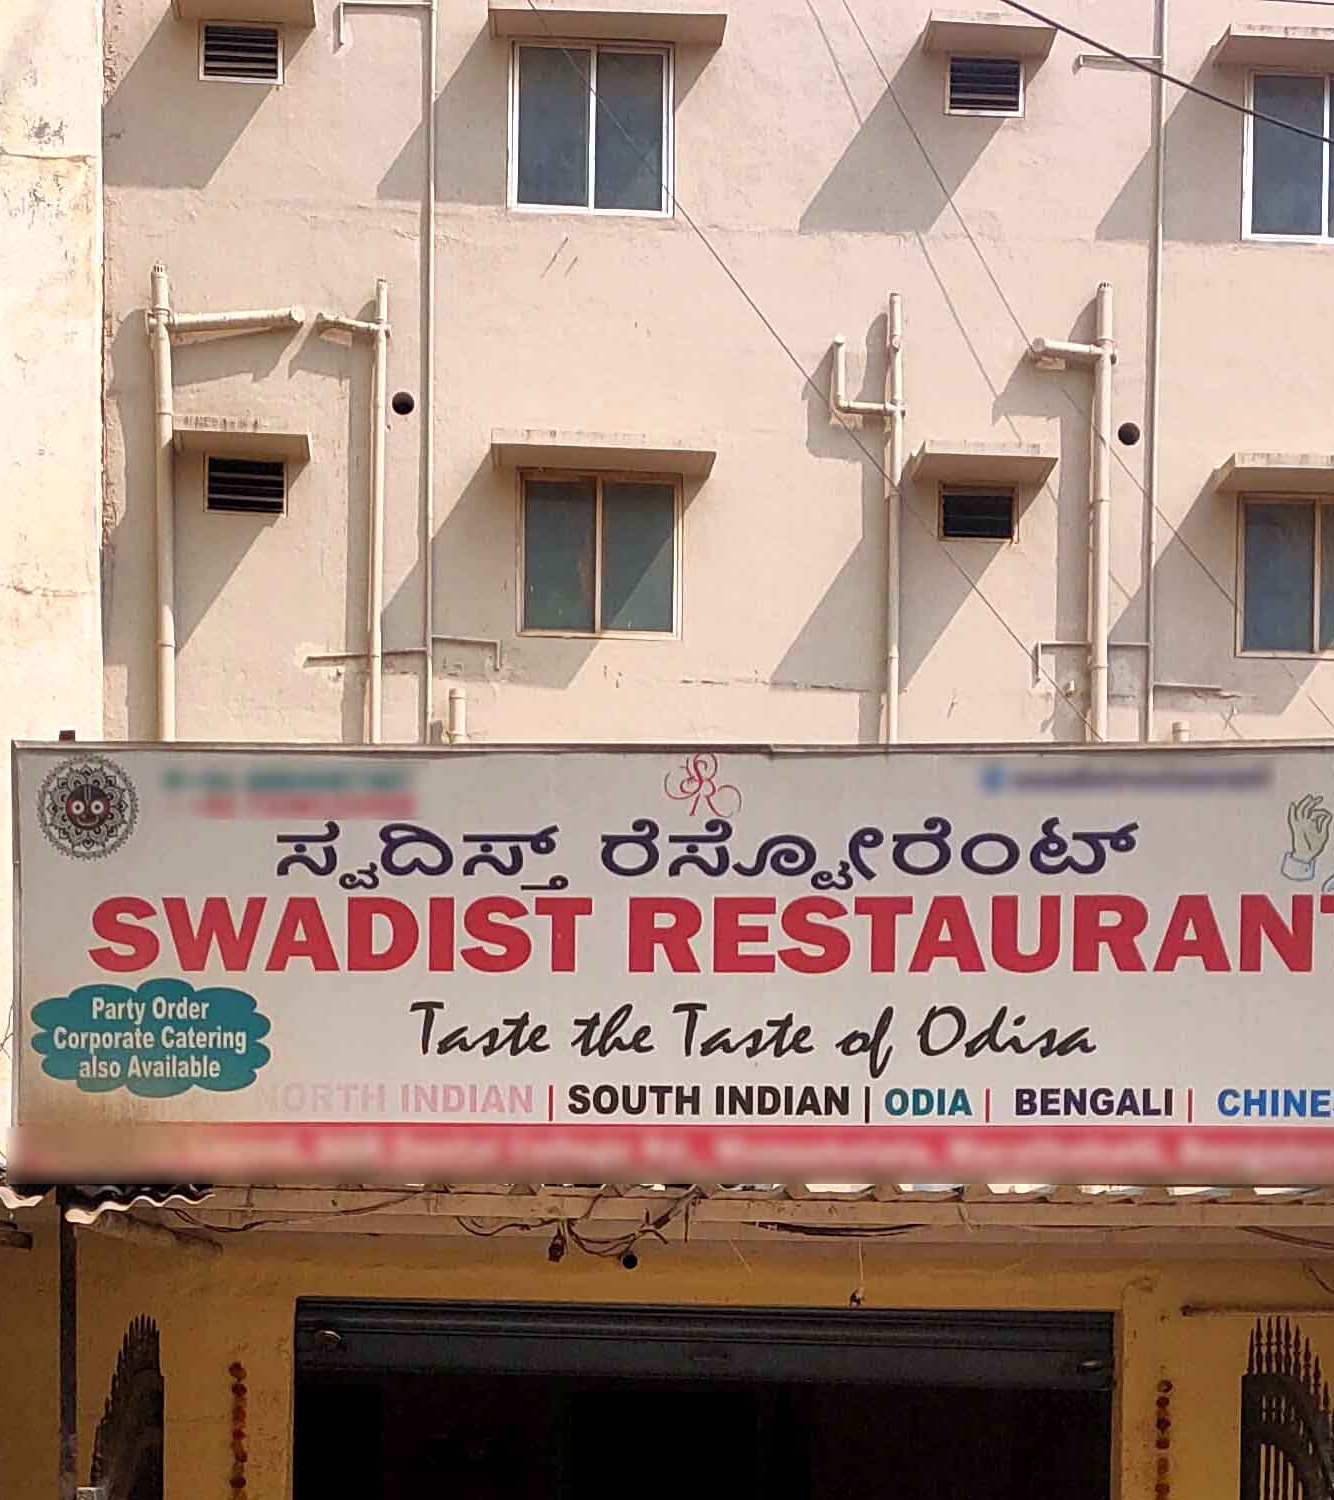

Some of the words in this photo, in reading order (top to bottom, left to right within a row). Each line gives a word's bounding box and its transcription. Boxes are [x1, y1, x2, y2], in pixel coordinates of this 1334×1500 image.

[600, 816, 1140, 891] ರೆಸ್ಟೋರೆಂಟ್
[89, 895, 594, 974] SWADIST
[91, 995, 145, 1025] Party
[152, 995, 210, 1020] Order
[53, 1025, 156, 1053] Corporate
[161, 1025, 248, 1054] Catering
[409, 1001, 550, 1057] Taste
[570, 1003, 655, 1058] the
[672, 1002, 814, 1059] Taste
[834, 1006, 894, 1079] of
[916, 1005, 1097, 1059] Odisa
[78, 1056, 121, 1079] also
[127, 1055, 221, 1079] Available
[401, 1083, 533, 1114] INDIAN
[567, 1084, 700, 1116] SOUTH
[715, 1085, 850, 1116] INDIAN
[884, 1087, 973, 1116] ODIA
[1015, 1087, 1173, 1116] BENGALI
